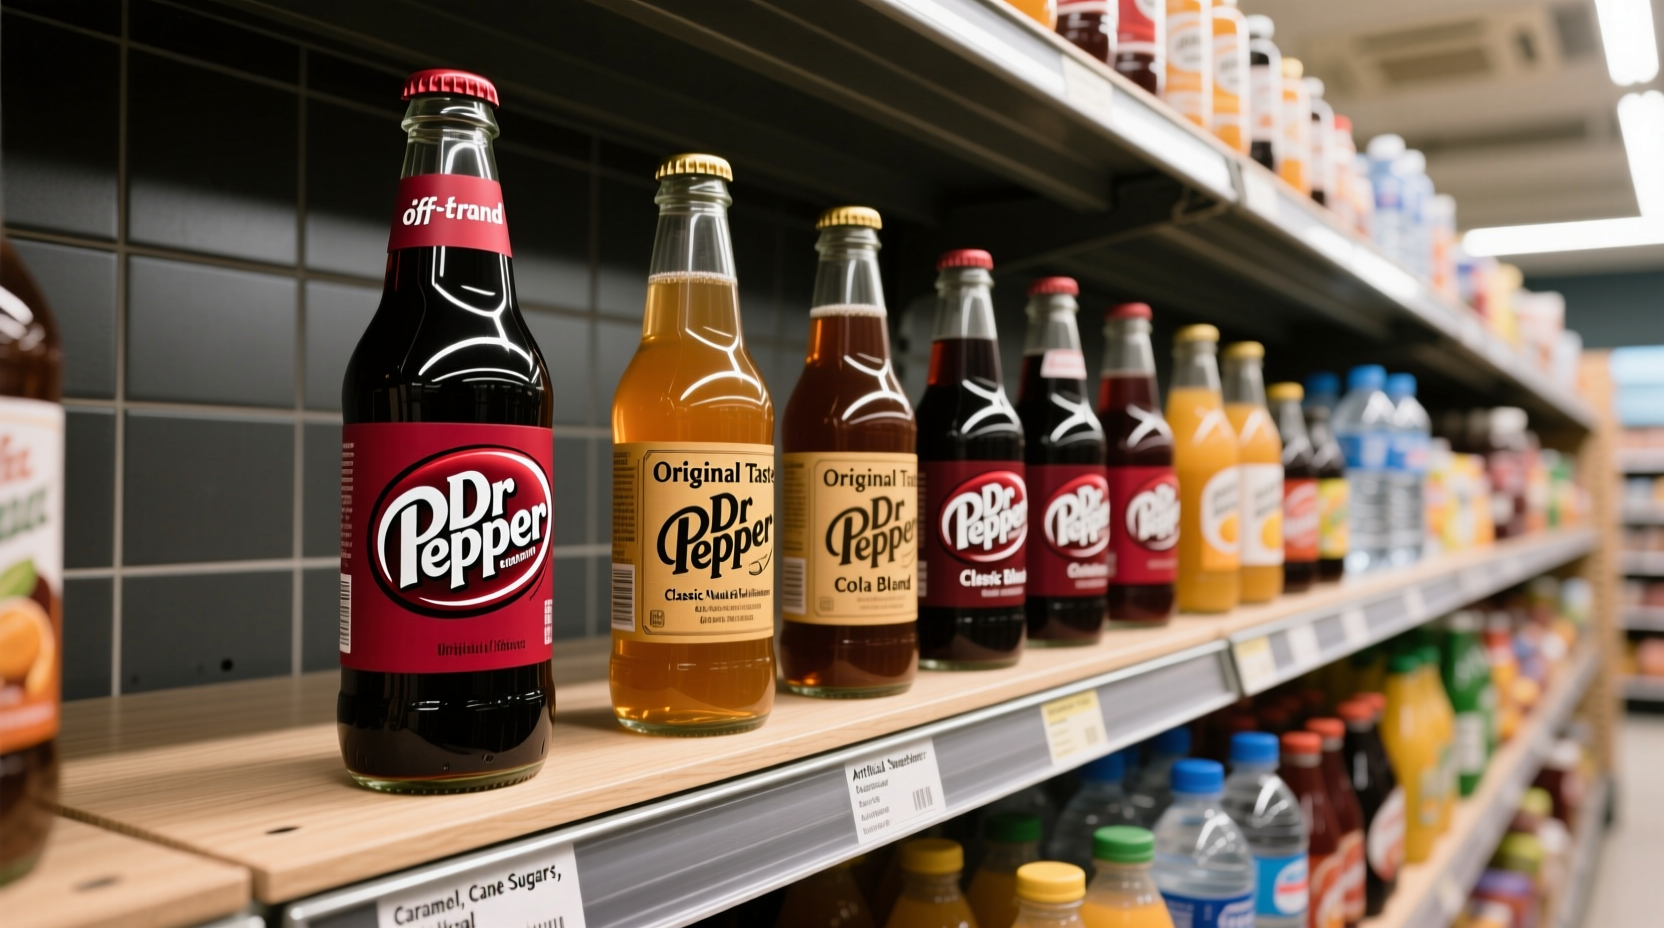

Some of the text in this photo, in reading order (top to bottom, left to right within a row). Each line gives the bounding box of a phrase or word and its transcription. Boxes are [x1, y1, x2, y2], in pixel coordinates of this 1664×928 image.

[653, 461, 740, 489] Original
[823, 468, 896, 493] Original
[448, 470, 515, 529] Dr
[710, 492, 753, 534] Dr
[870, 496, 905, 531] Dr
[981, 482, 1015, 518] Dr
[377, 486, 547, 590] Pepper
[656, 505, 773, 579] Pepper
[825, 506, 917, 569] Pepper
[665, 588, 704, 601] Classic
[835, 576, 872, 593] Cola
[468, 880, 505, 903] Cane
[507, 864, 562, 892] Sugars,
